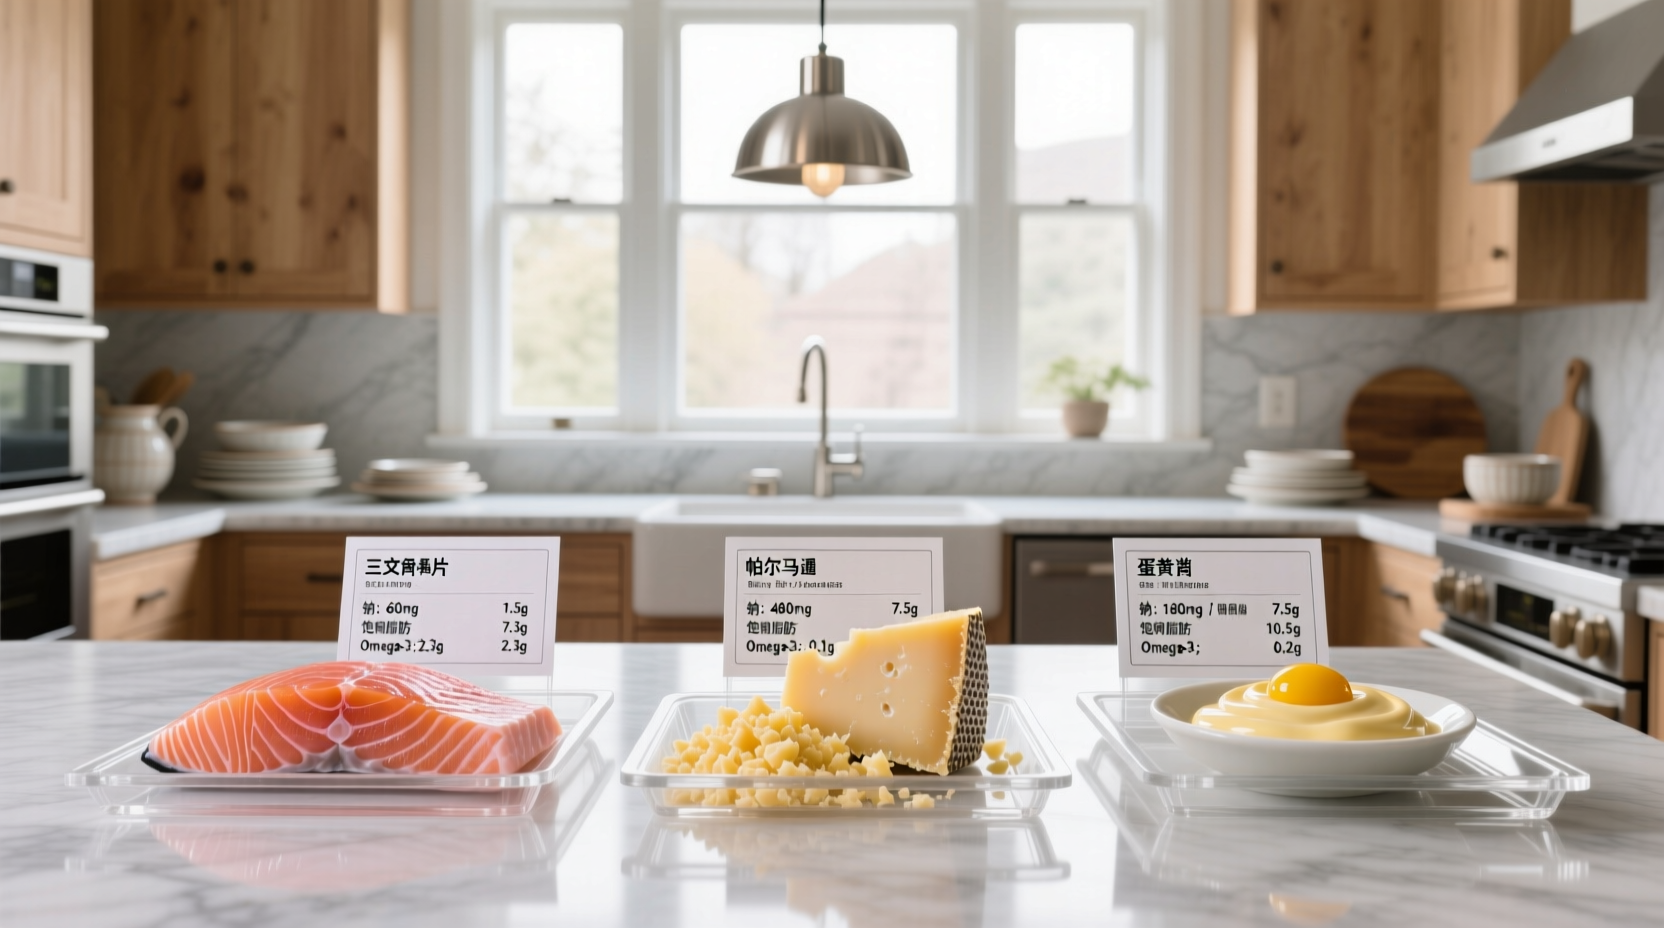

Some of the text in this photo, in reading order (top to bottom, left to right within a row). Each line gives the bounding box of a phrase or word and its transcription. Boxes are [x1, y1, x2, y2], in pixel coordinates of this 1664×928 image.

[502, 601, 529, 617] 1.5g
[891, 601, 919, 618] 7.5g
[1272, 602, 1300, 619] 7.5g
[502, 621, 528, 637] 7.3g
[1266, 622, 1301, 638] 10.5g
[501, 639, 528, 655] 2.3g
[1273, 640, 1302, 657] 0.2g
